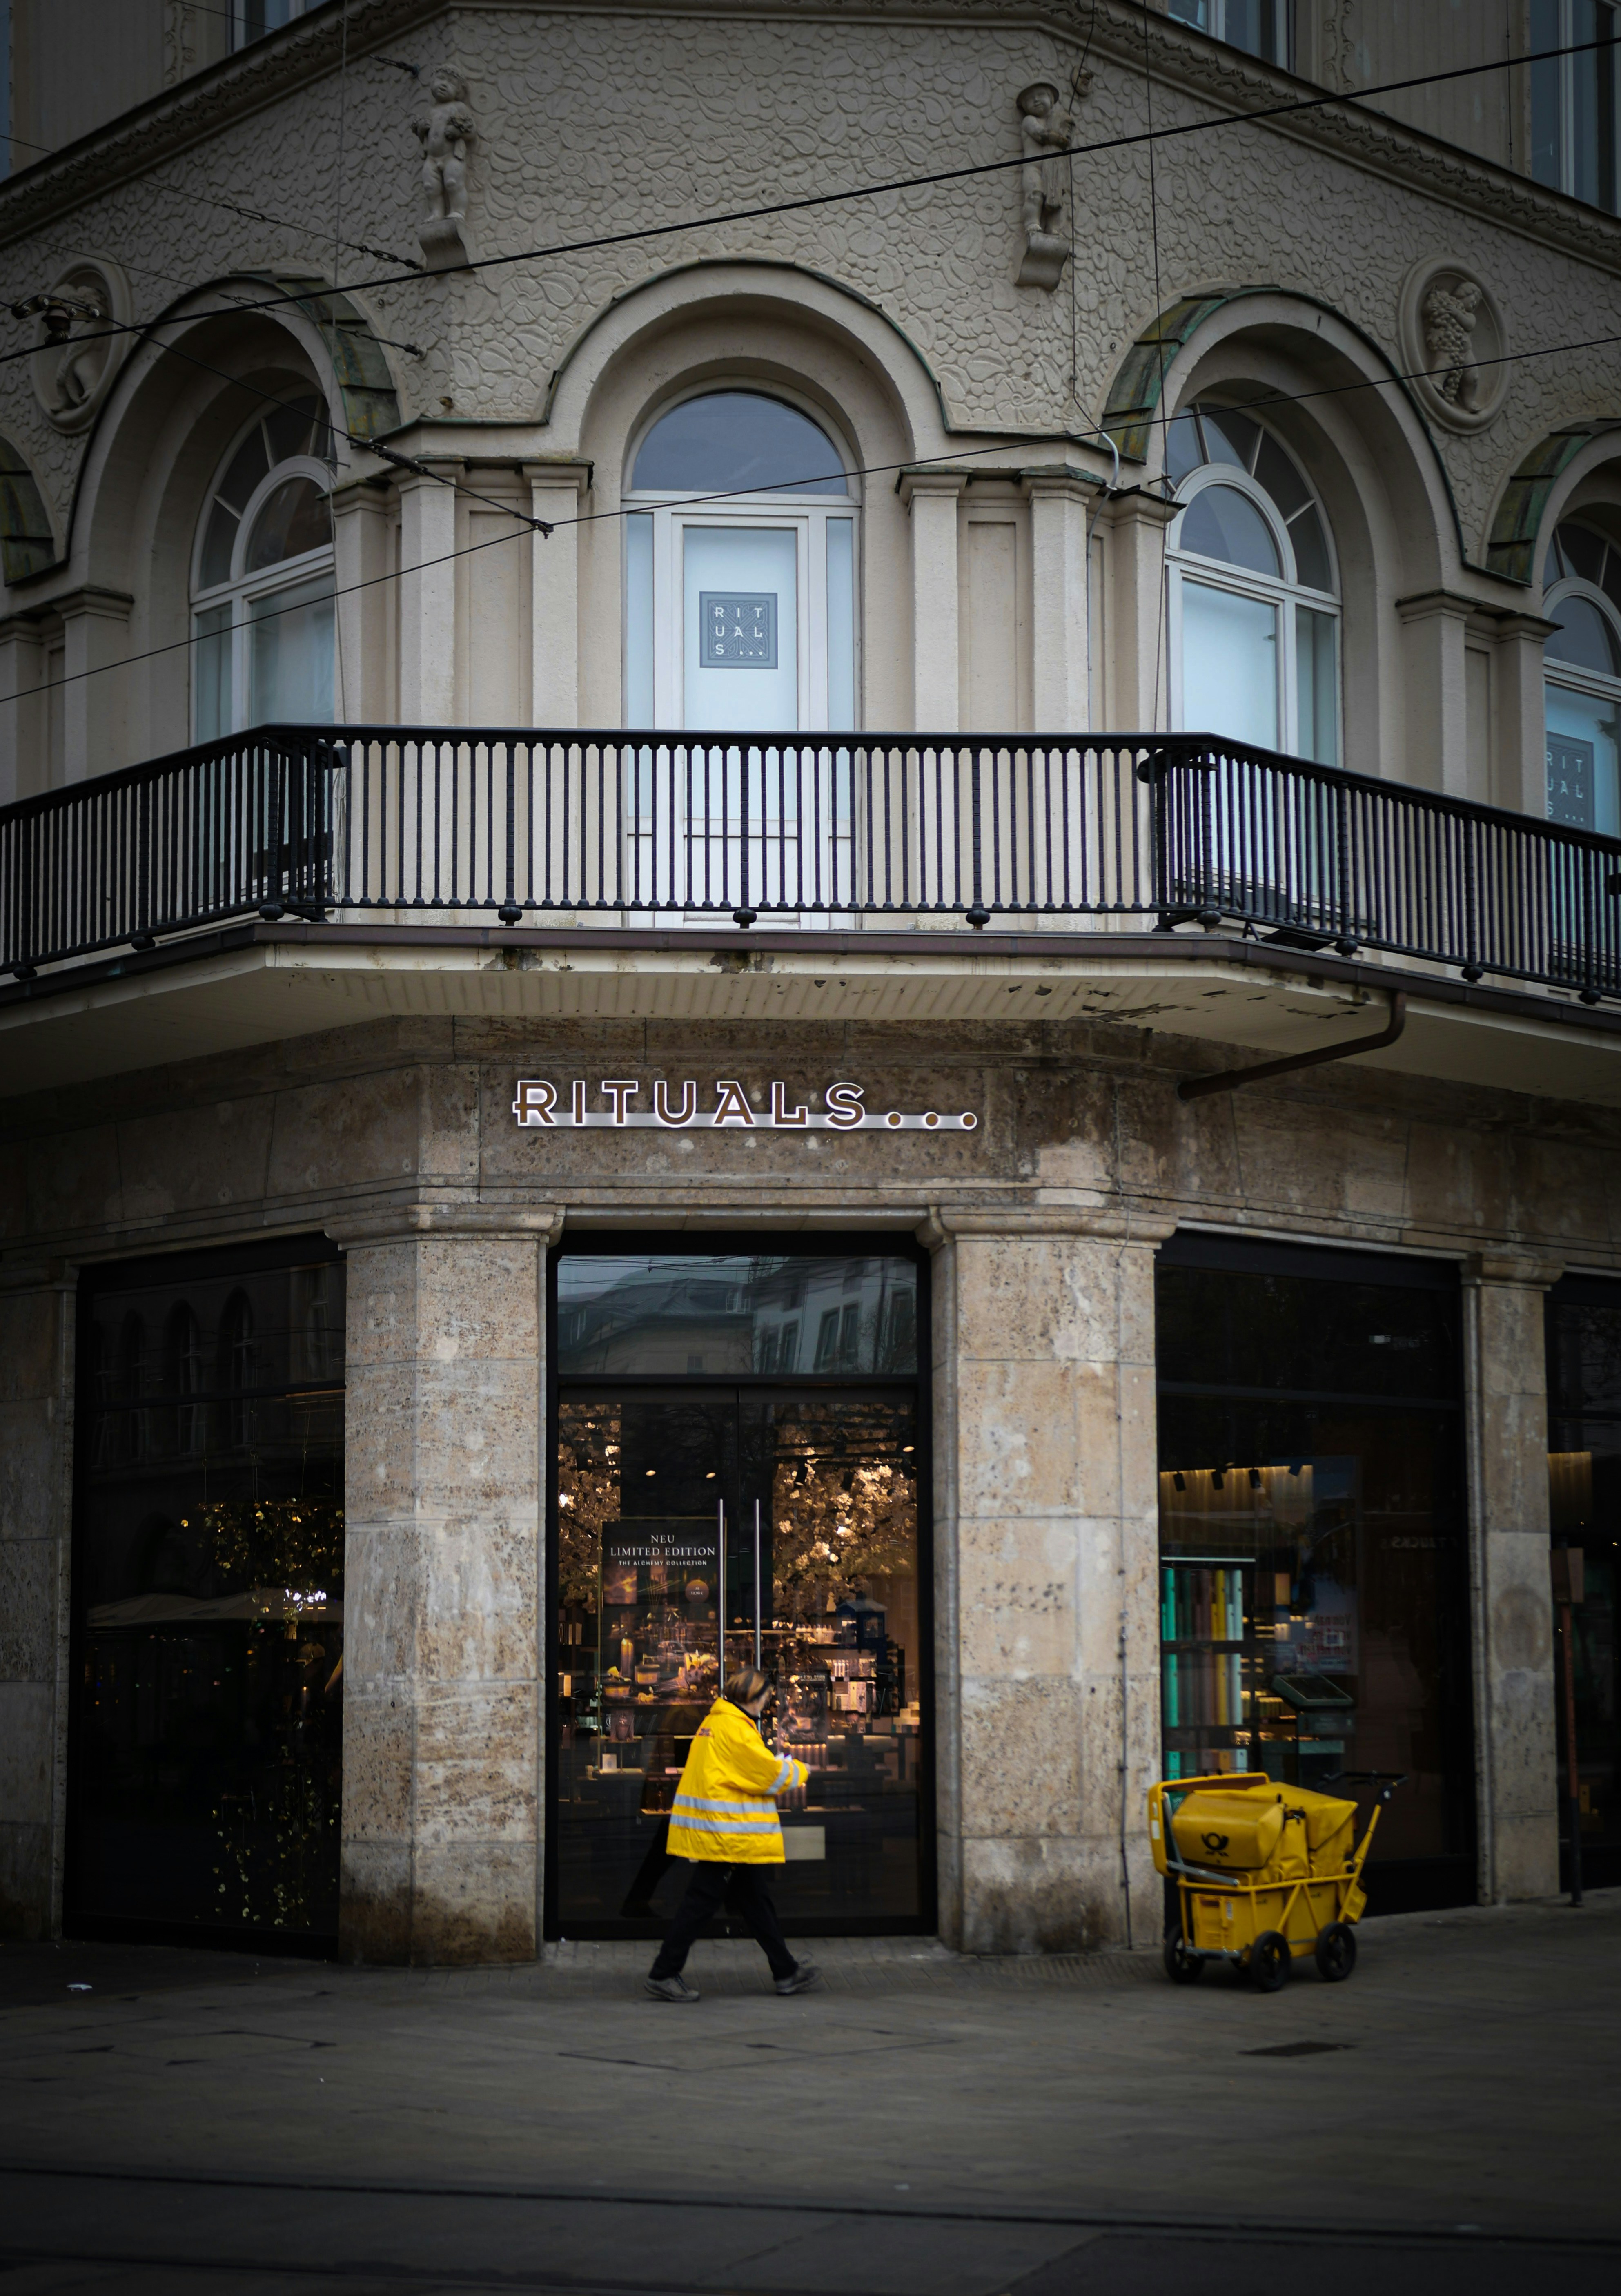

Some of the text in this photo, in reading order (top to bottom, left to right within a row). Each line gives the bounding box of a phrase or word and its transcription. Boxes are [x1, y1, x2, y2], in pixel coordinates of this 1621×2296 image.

[650, 1534, 675, 1543] NEU
[610, 1547, 715, 1556] LIMITED EDITION
